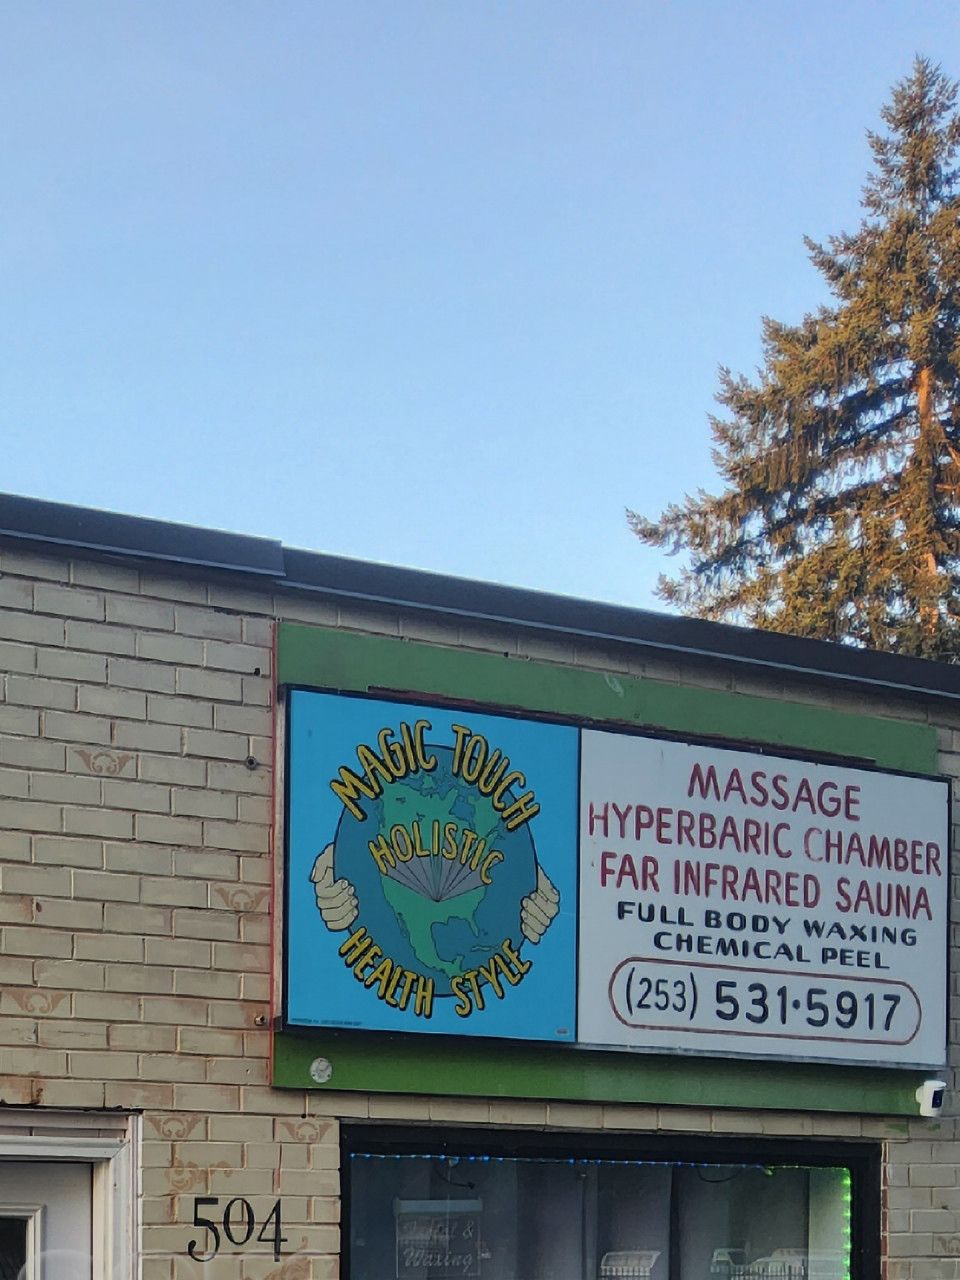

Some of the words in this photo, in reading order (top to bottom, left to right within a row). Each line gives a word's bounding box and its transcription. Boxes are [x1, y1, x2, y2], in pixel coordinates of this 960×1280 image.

[330, 720, 439, 822] MAGIC
[451, 724, 540, 831] TOUCH
[688, 763, 861, 821] MASSAGE
[368, 820, 504, 885] HOLISTIC
[589, 802, 792, 858] HYPERBARIC
[804, 827, 941, 876] CHAMBER
[601, 852, 660, 892] FAR
[674, 859, 821, 908] INFRARED
[836, 877, 933, 921] SAUNA
[617, 901, 694, 926] FULL
[705, 909, 790, 934] BODY
[803, 919, 917, 946] WAXING
[654, 931, 811, 963] CHEMICAL
[822, 948, 890, 969] PEEL
[338, 927, 434, 1018] HEALTH
[451, 939, 533, 1018] STYLE
[626, 967, 698, 1020] (253)
[188, 1197, 288, 1262] 504
[403, 1247, 473, 1273] Waxing
